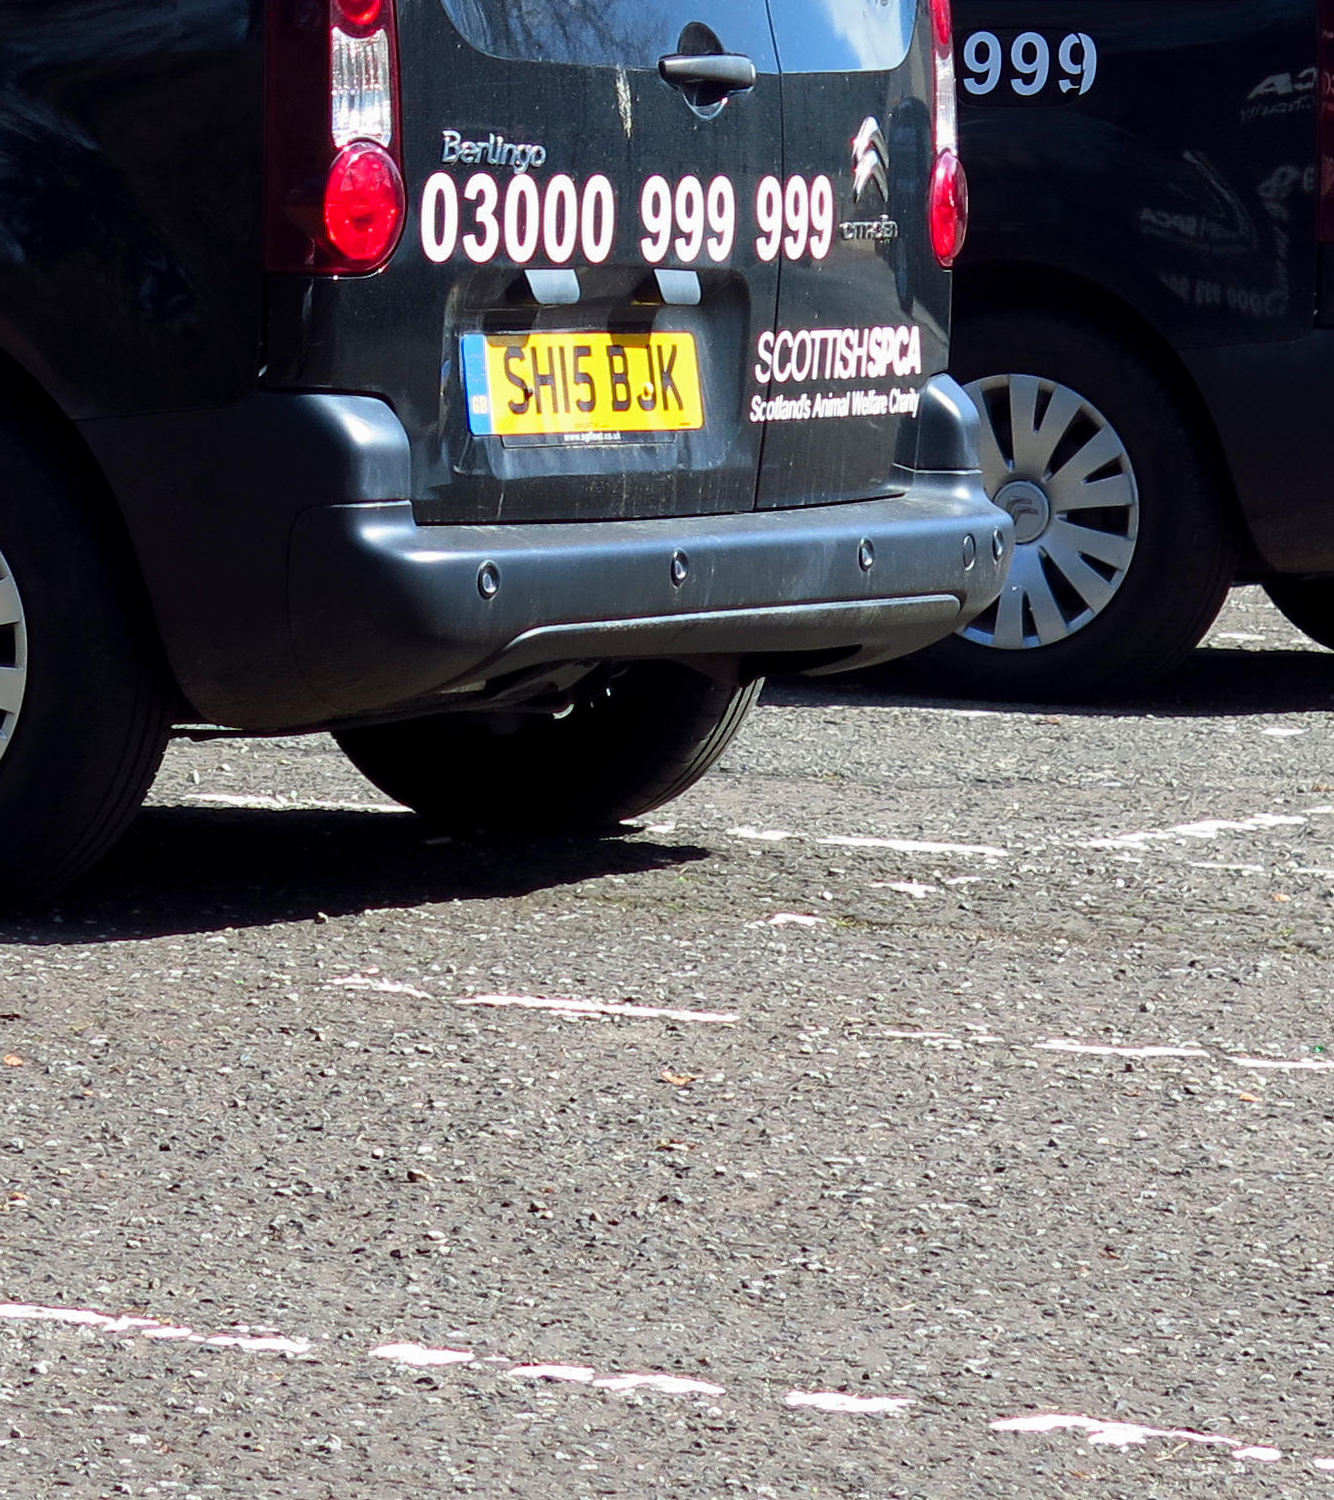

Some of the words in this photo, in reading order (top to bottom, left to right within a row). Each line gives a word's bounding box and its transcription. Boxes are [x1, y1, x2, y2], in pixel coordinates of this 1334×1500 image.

[962, 30, 1097, 96] 999
[441, 128, 547, 174] Berlingo
[420, 170, 615, 264] 03000
[640, 173, 736, 264] 999
[755, 173, 834, 262] 999
[503, 344, 597, 415] SH15
[605, 343, 684, 413] BJK
